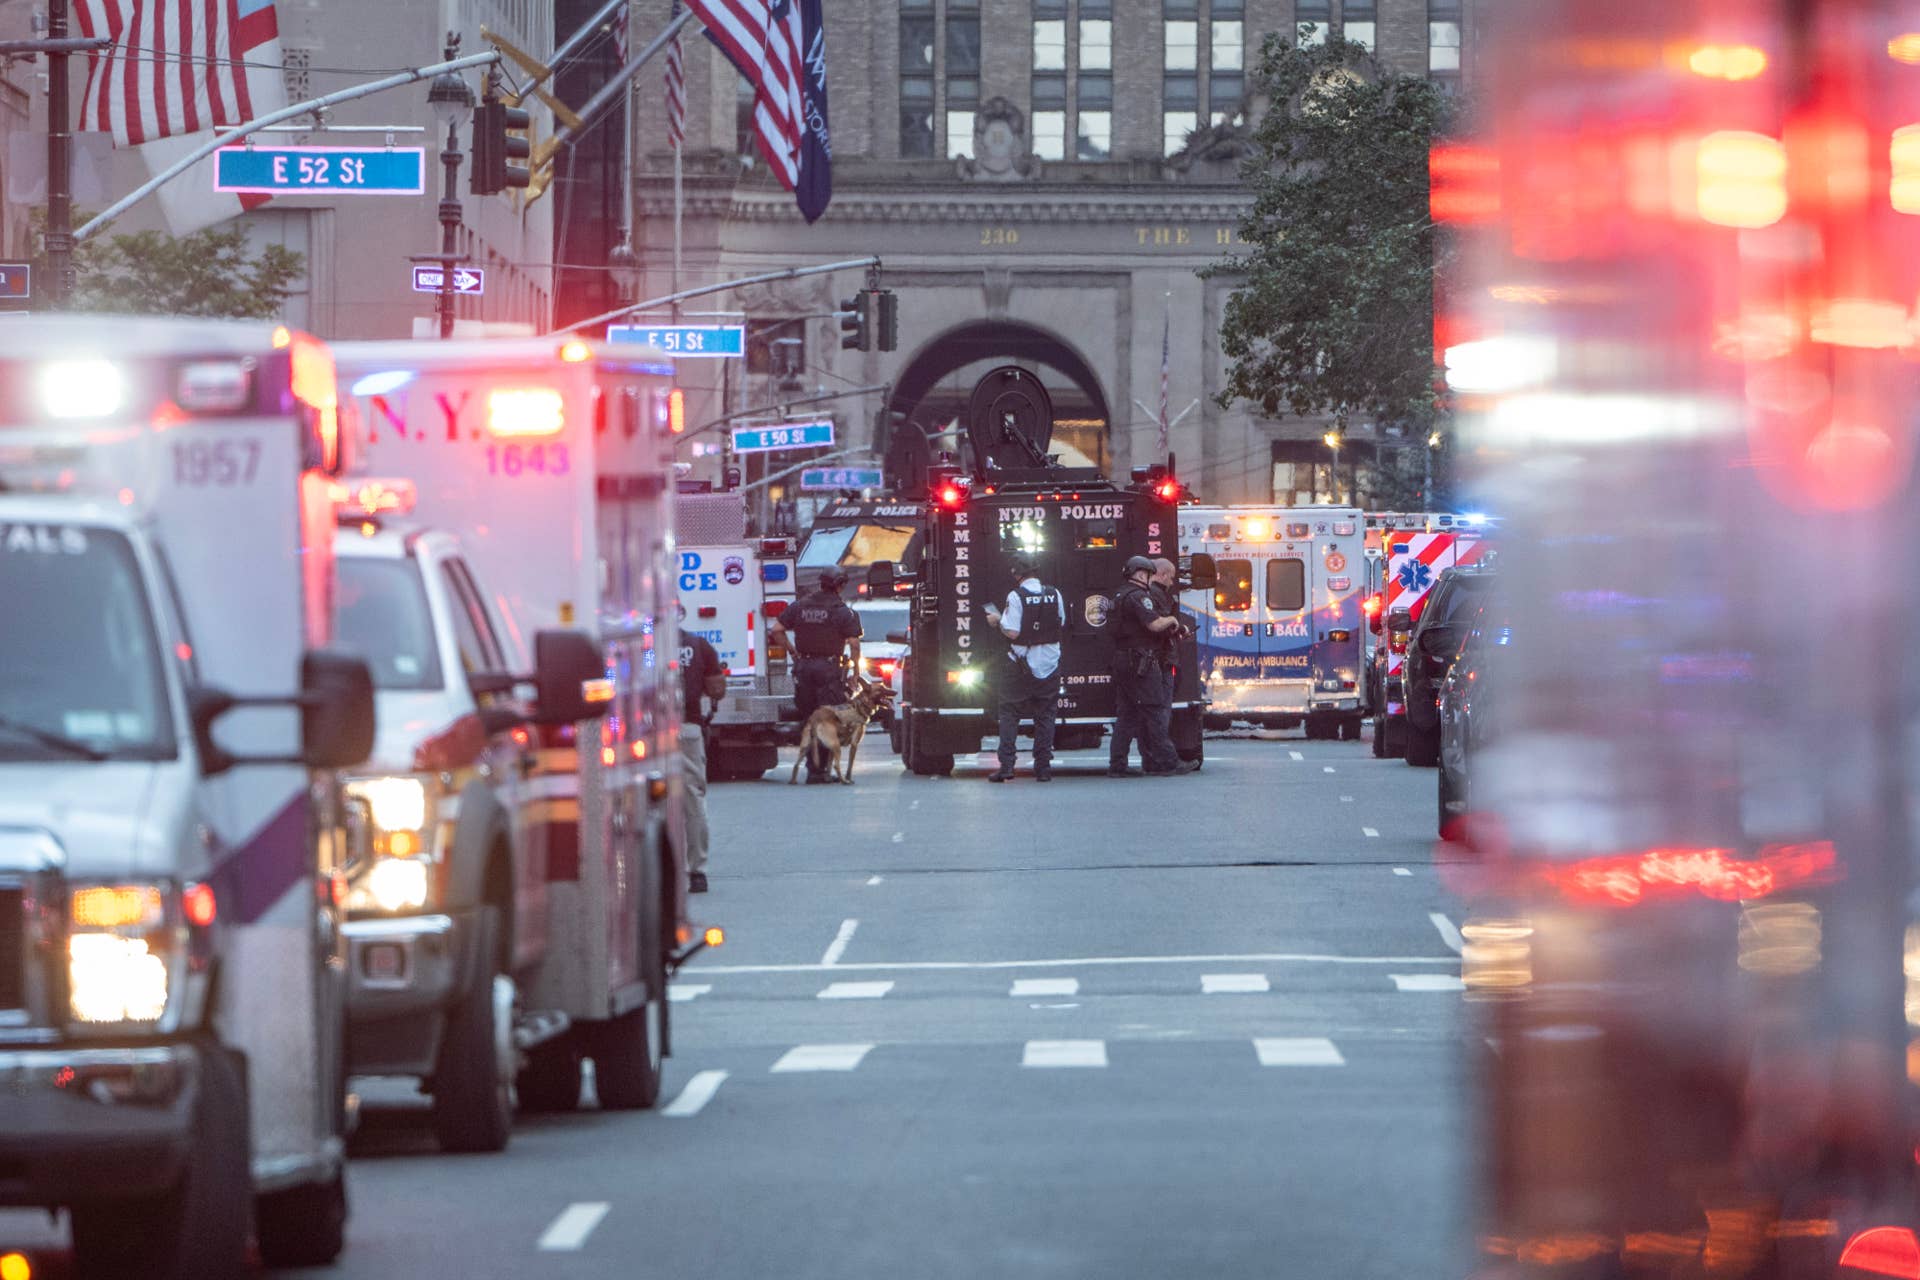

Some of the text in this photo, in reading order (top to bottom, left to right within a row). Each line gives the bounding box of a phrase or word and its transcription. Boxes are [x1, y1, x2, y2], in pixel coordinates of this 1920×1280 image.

[273, 156, 365, 184] E 52 St
[980, 229, 1019, 245] 230
[1134, 228, 1190, 245] THE
[420, 274, 440, 285] ONE
[664, 332, 680, 350] 51
[686, 332, 704, 350] St
[760, 429, 806, 446] E 50 St
[171, 438, 263, 486] 1957
[486, 442, 571, 478] 1643
[999, 504, 1123, 521] NYPD POLICE
[953, 512, 972, 665] EMERGENCY
[1211, 624, 1309, 638] KEEP BACK
[1257, 655, 1309, 668] AMBULANCE
[1067, 675, 1085, 685] 200
[1088, 674, 1112, 684] FEET
